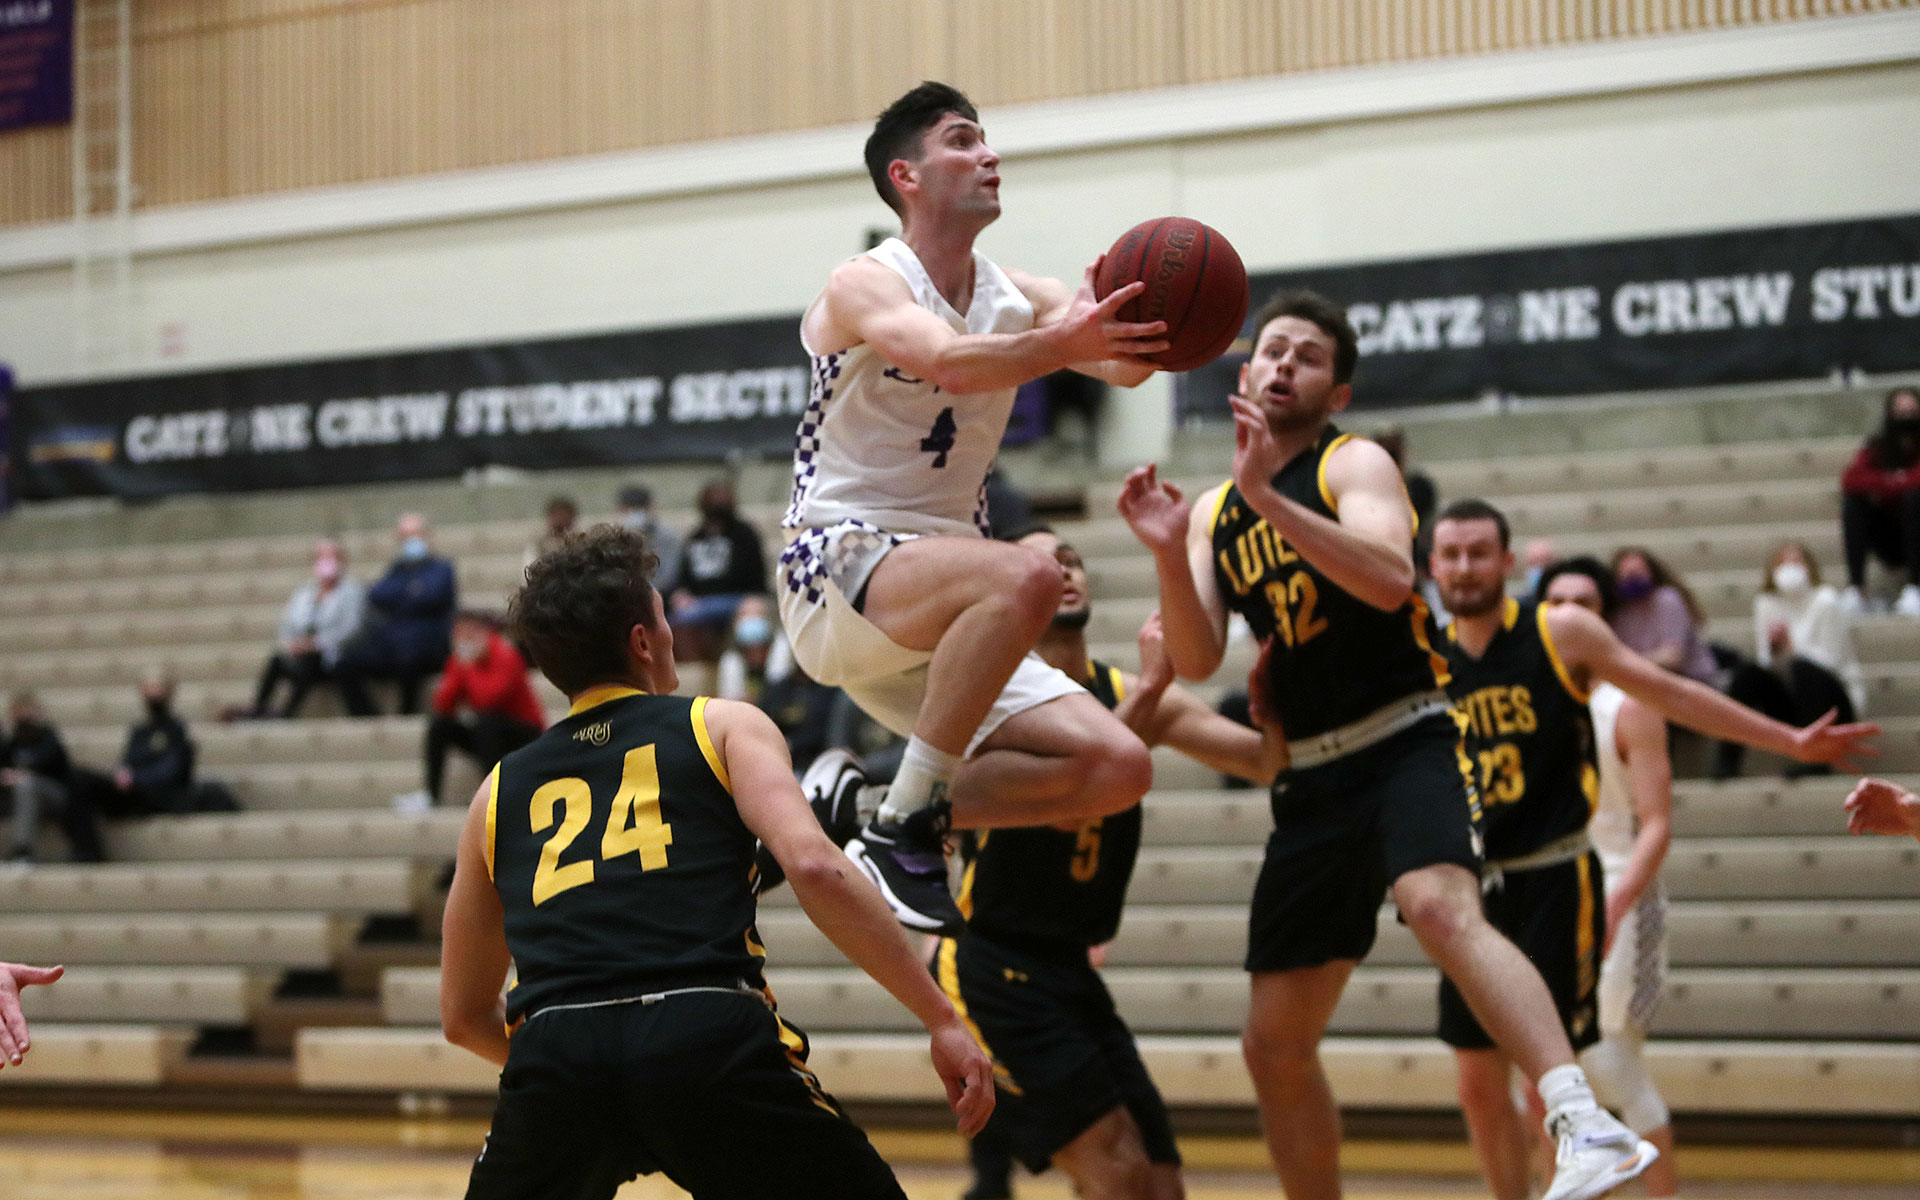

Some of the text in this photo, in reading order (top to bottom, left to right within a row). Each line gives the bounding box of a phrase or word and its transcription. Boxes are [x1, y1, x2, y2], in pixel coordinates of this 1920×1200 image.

[1611, 269, 1795, 337] CREW
[1810, 261, 1920, 323] STU
[315, 391, 450, 449] CREW
[454, 374, 664, 438] STUDENT
[919, 406, 958, 469] 4
[1265, 570, 1329, 648] 32
[1477, 742, 1525, 807] 23
[529, 742, 674, 908] 24
[1070, 817, 1102, 883] 5
